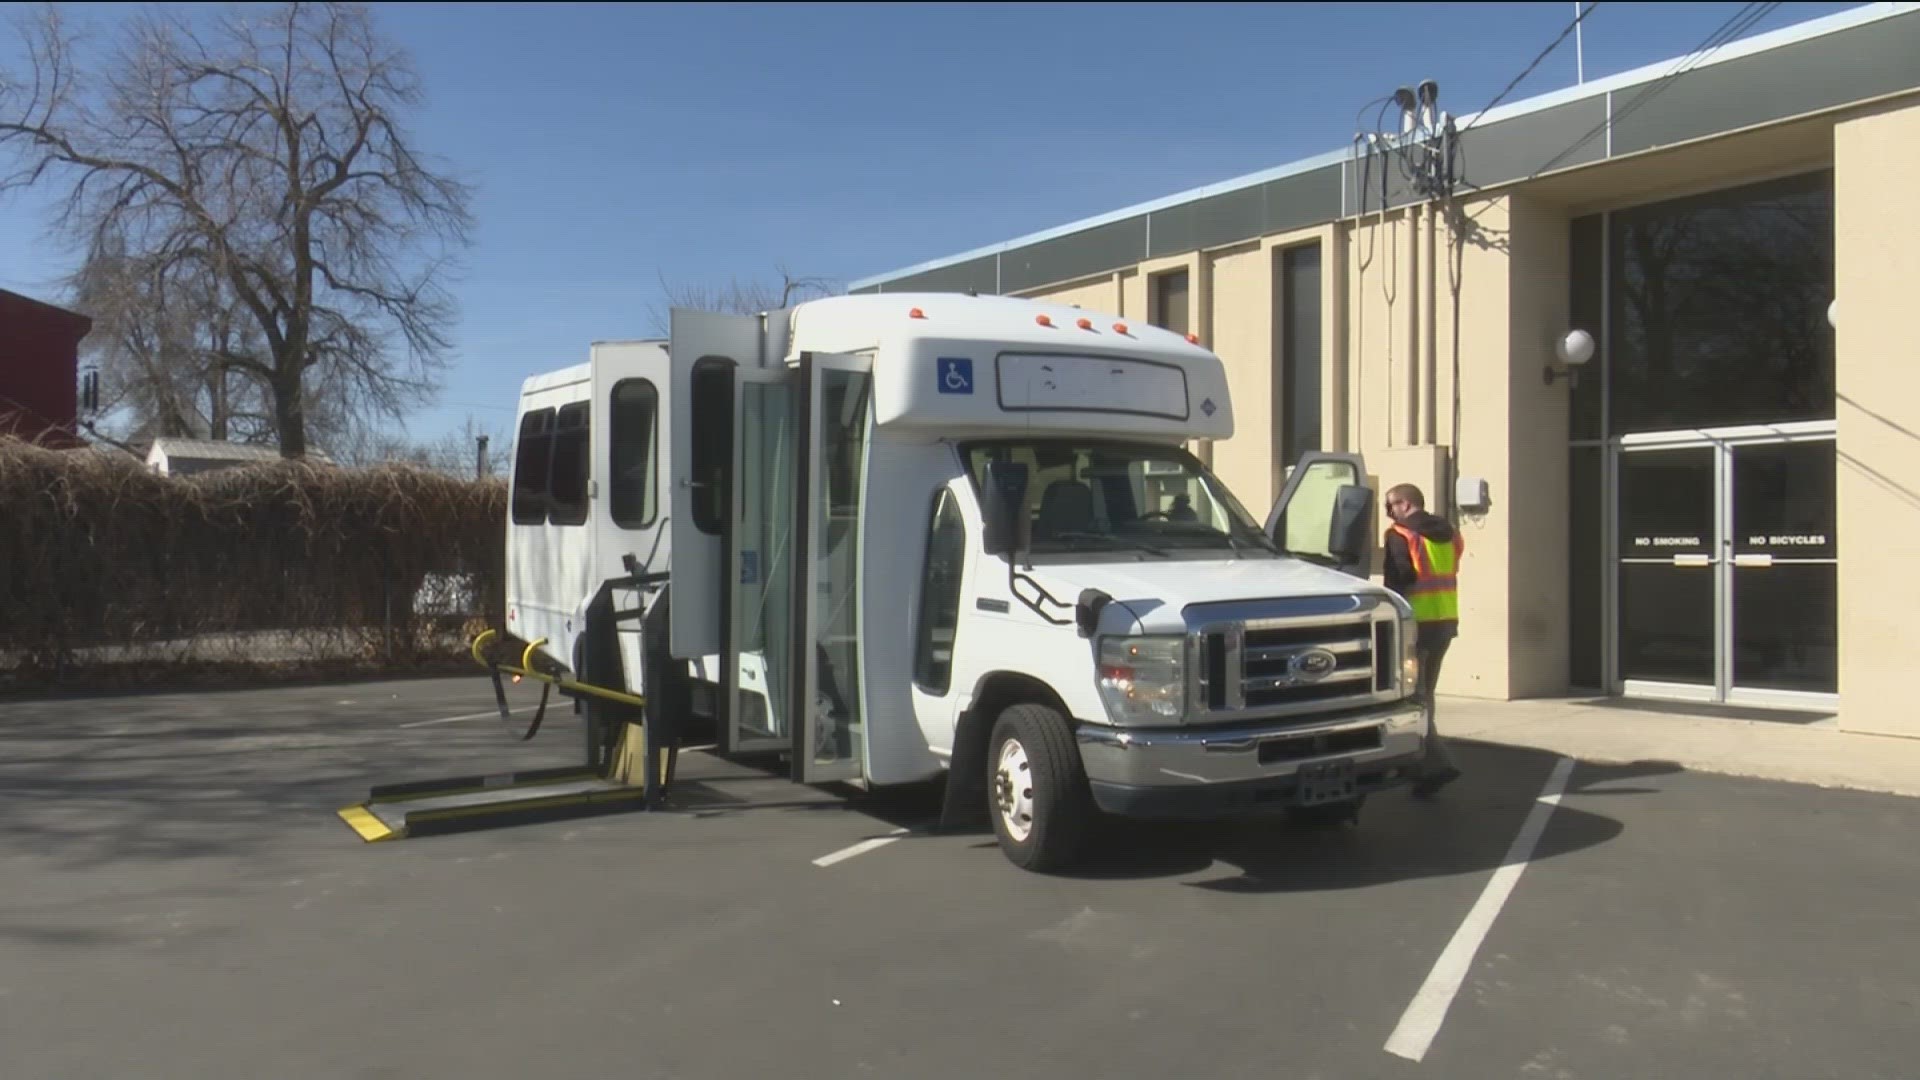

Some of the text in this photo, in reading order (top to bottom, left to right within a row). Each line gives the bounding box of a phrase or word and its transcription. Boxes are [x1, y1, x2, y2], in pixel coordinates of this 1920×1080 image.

[1635, 537, 1700, 546] NO SMOKING
[1749, 535, 1826, 545] NO BICYCLES
